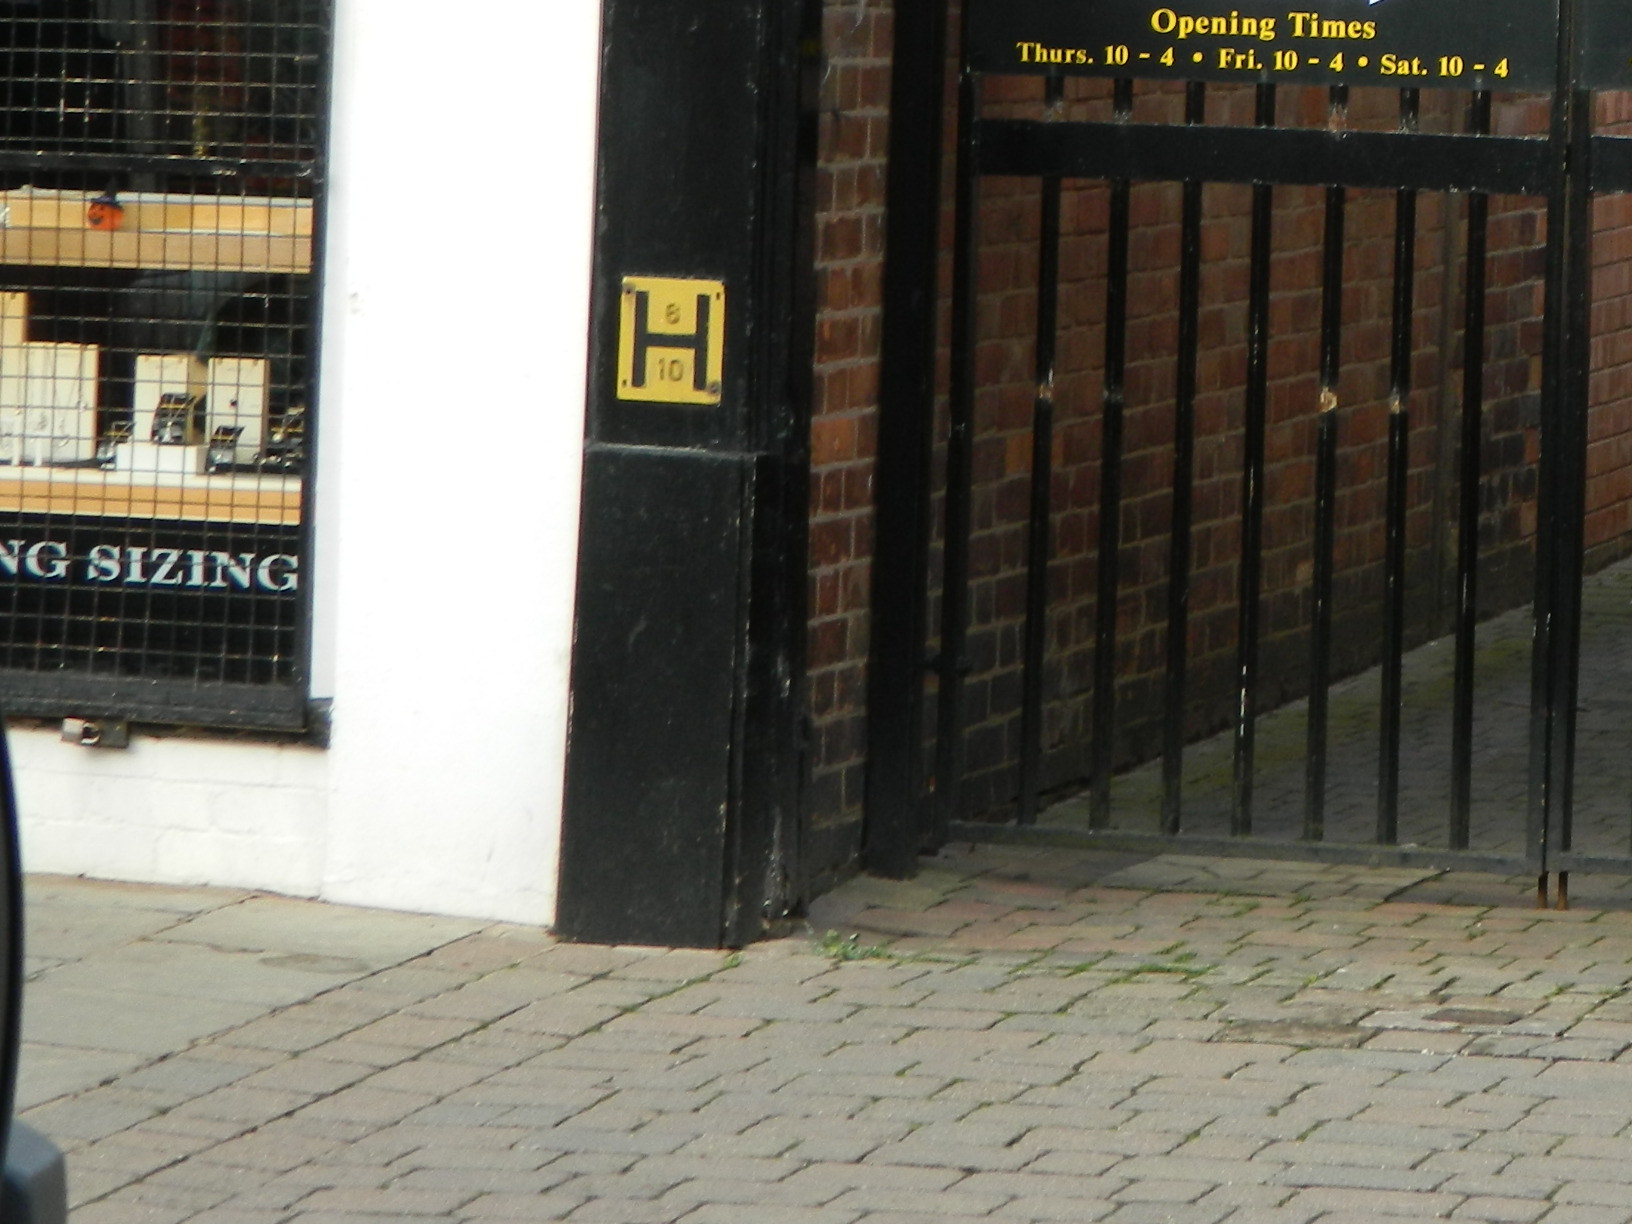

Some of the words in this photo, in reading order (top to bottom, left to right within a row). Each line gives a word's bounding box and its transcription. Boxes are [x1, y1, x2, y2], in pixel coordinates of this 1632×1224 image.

[1150, 8, 1277, 42] Opening
[1287, 12, 1376, 40] Times
[1017, 42, 1094, 64] Thurs.
[1105, 45, 1129, 66] 10
[1159, 47, 1175, 67] 4
[1218, 47, 1263, 70] Fri.
[1273, 50, 1299, 71] 10
[1328, 52, 1344, 73] 4
[1380, 54, 1428, 76] Sat.
[1438, 55, 1464, 77] 10
[1493, 58, 1509, 78] 4
[632, 290, 711, 391] H
[658, 357, 684, 382] 10
[87, 544, 299, 591] SIZING
